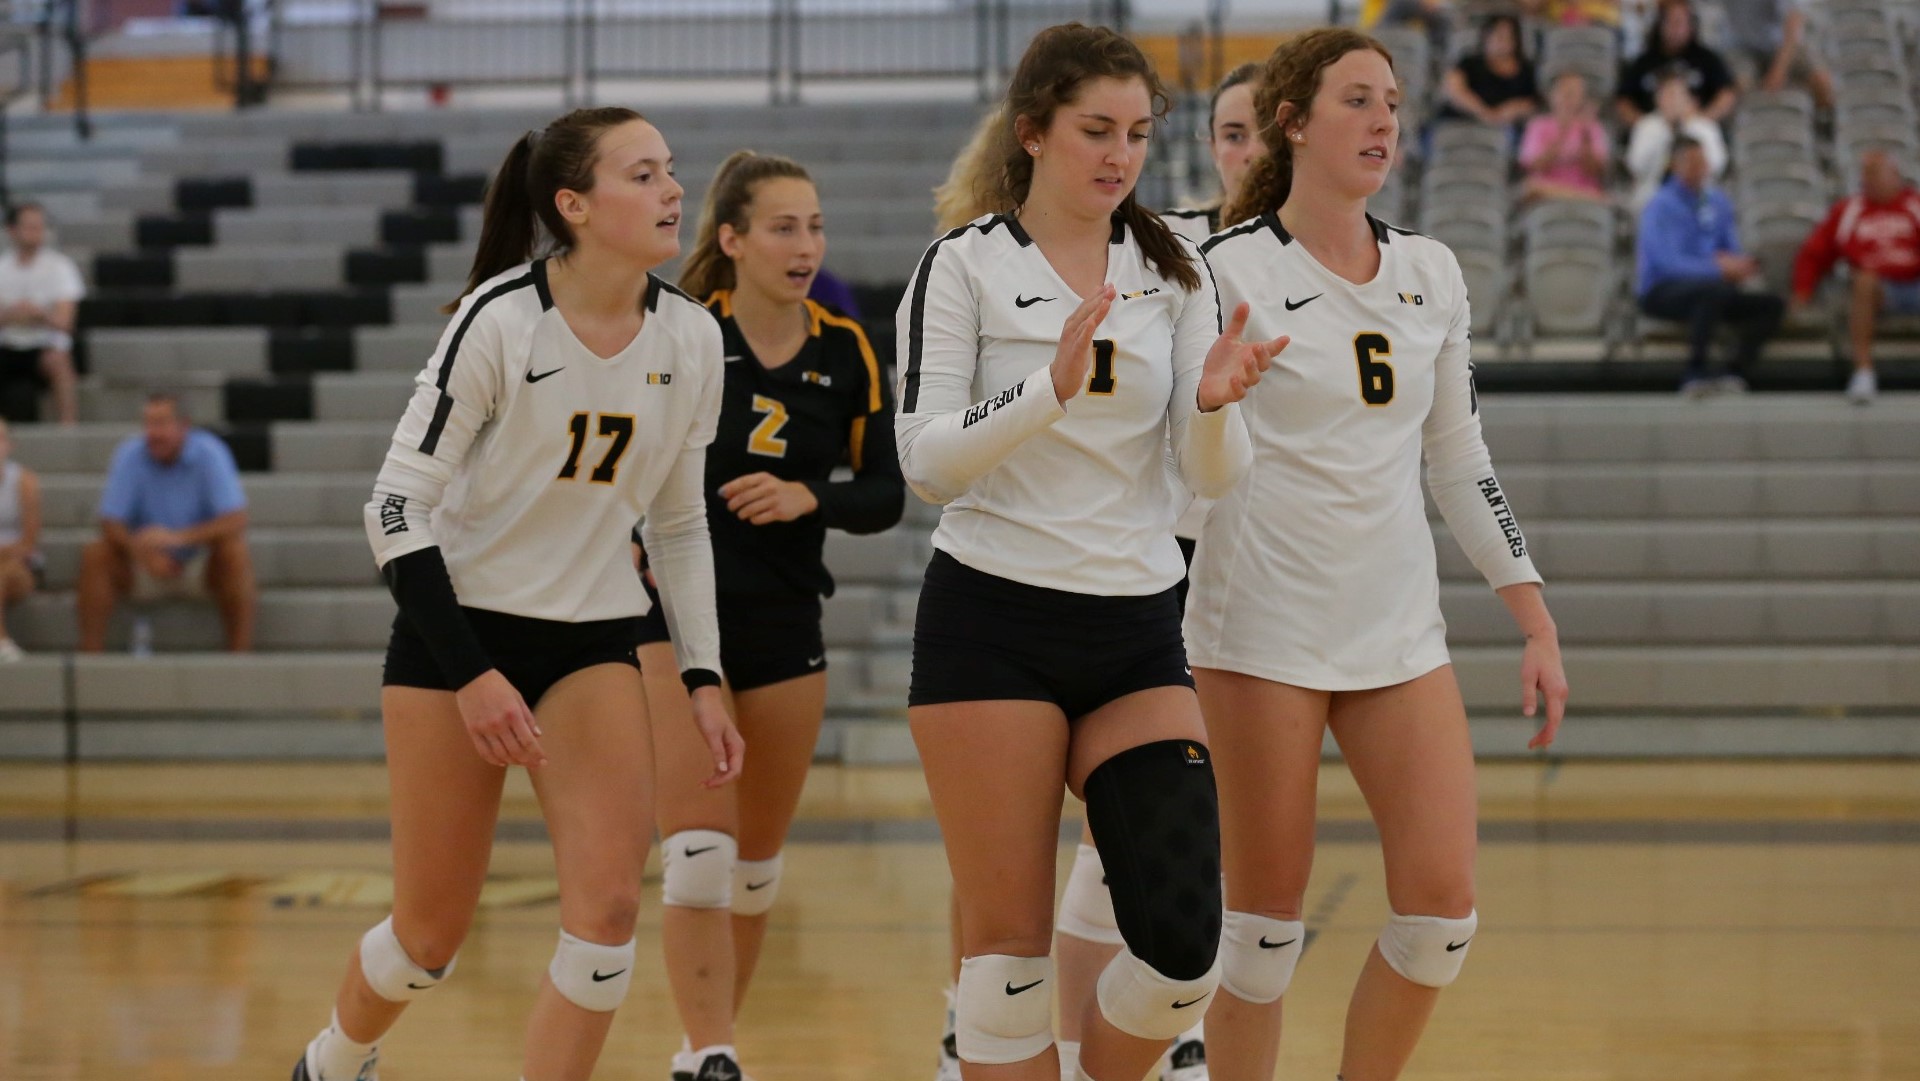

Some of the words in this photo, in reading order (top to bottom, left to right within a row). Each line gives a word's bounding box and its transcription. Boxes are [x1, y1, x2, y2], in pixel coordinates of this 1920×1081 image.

[962, 378, 1027, 430] ADELPHI
[1352, 331, 1395, 408] 6
[555, 410, 637, 486] 17
[747, 392, 790, 459] 2
[1477, 476, 1527, 558] PANTHERS
